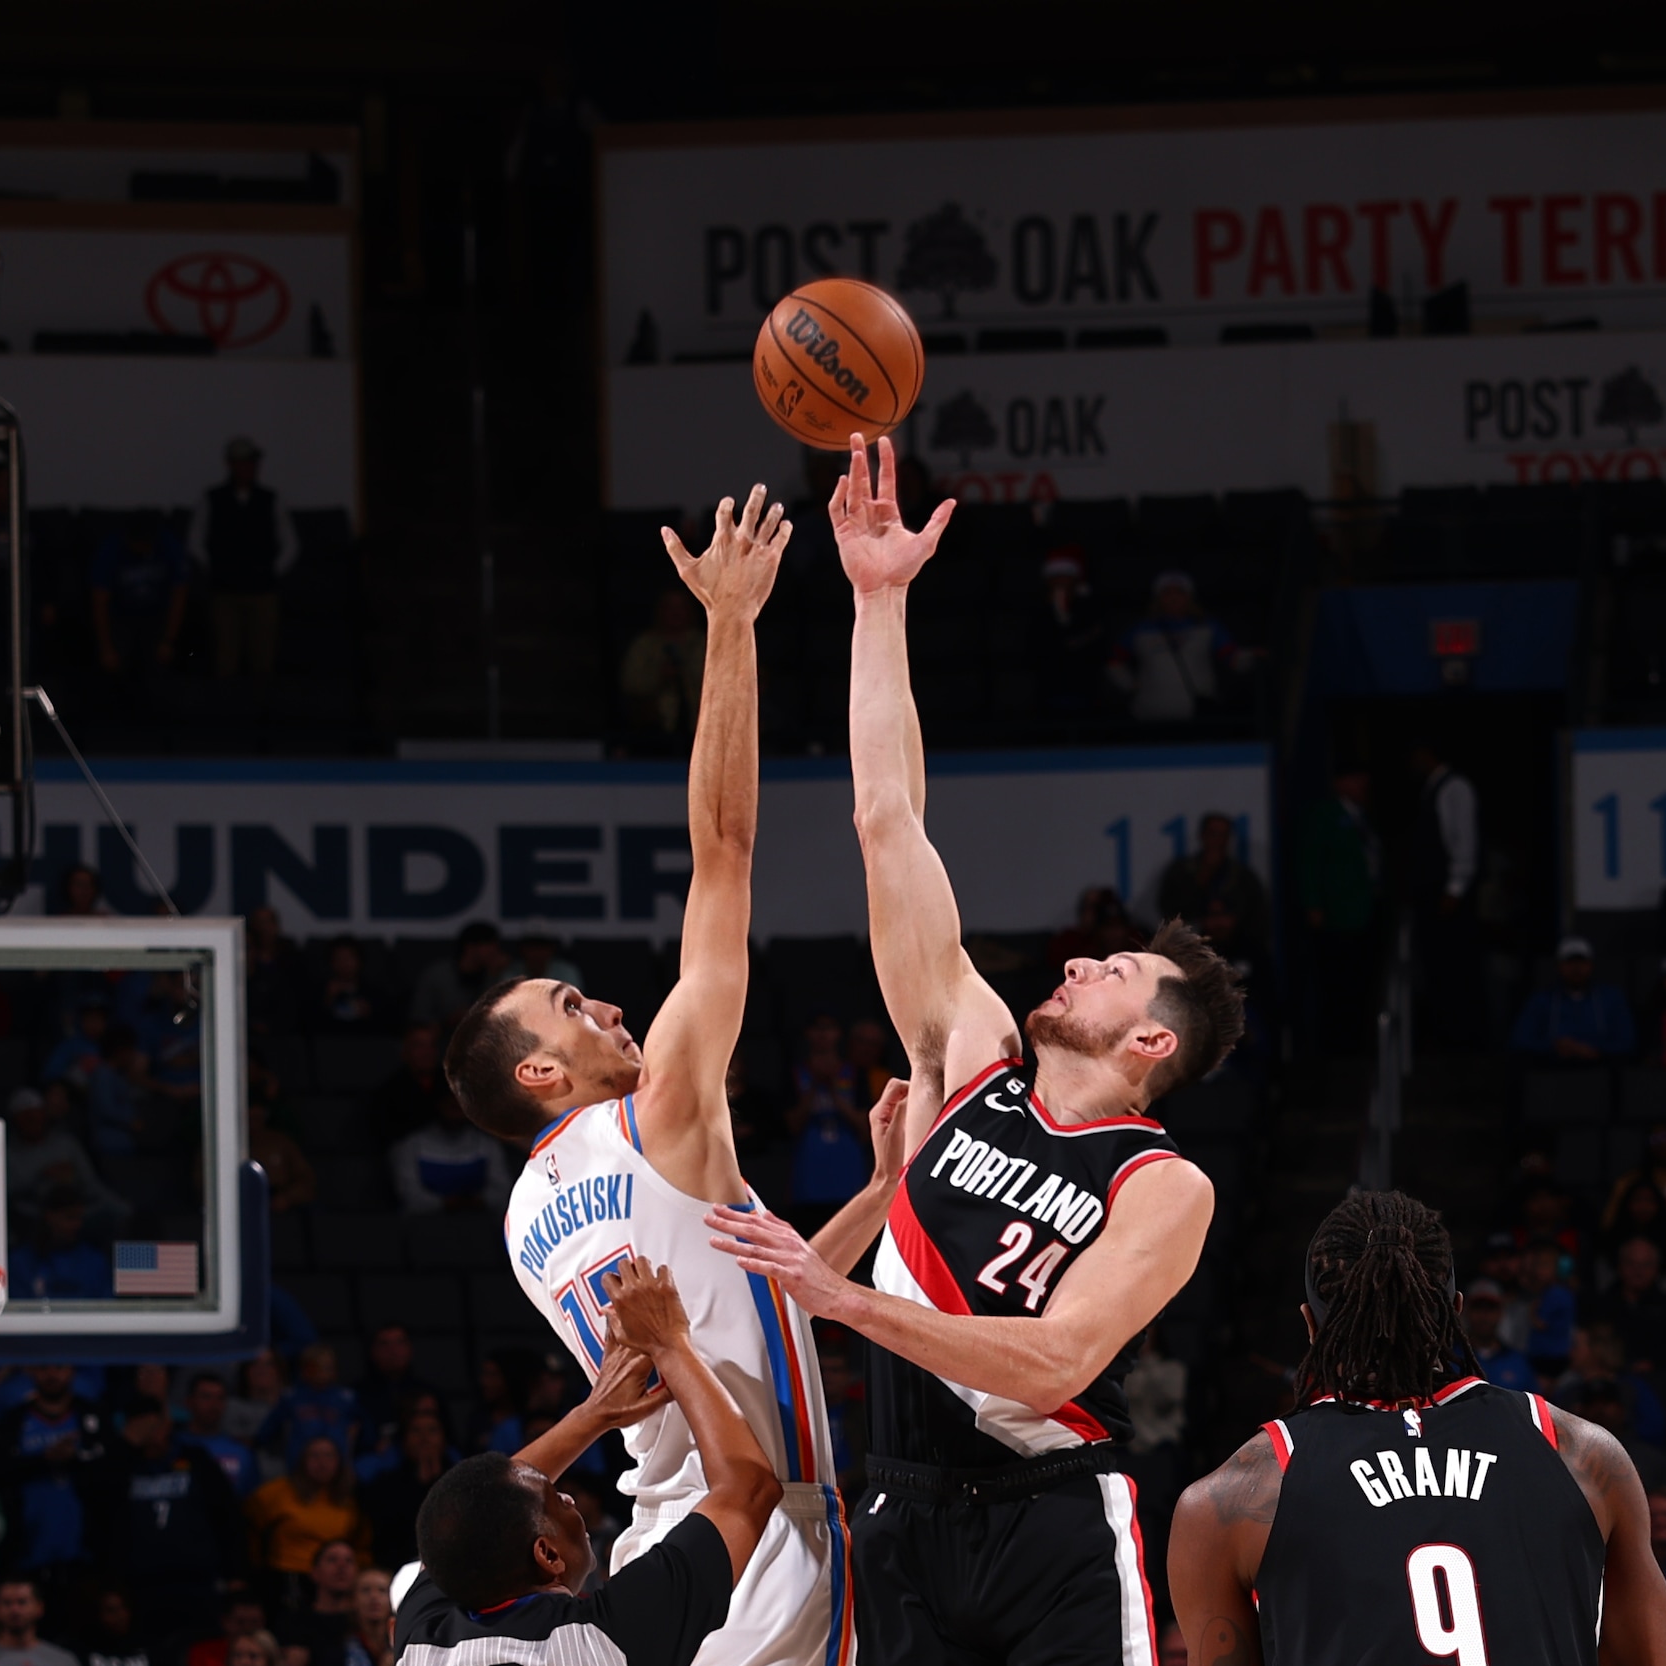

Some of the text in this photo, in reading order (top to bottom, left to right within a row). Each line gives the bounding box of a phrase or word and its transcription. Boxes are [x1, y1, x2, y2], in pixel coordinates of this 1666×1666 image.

[704, 221, 888, 316] POST
[1012, 211, 1159, 305] OAK
[1194, 201, 1457, 298] PARTY
[786, 307, 871, 407] Wilson
[1008, 395, 1105, 459] OAK
[1467, 376, 1589, 441] POST
[520, 1172, 633, 1283] POKUŠEVSKI
[930, 1127, 1105, 1245] PORTLAND
[975, 1220, 1071, 1312] 24
[1349, 1446, 1498, 1508] GRANT
